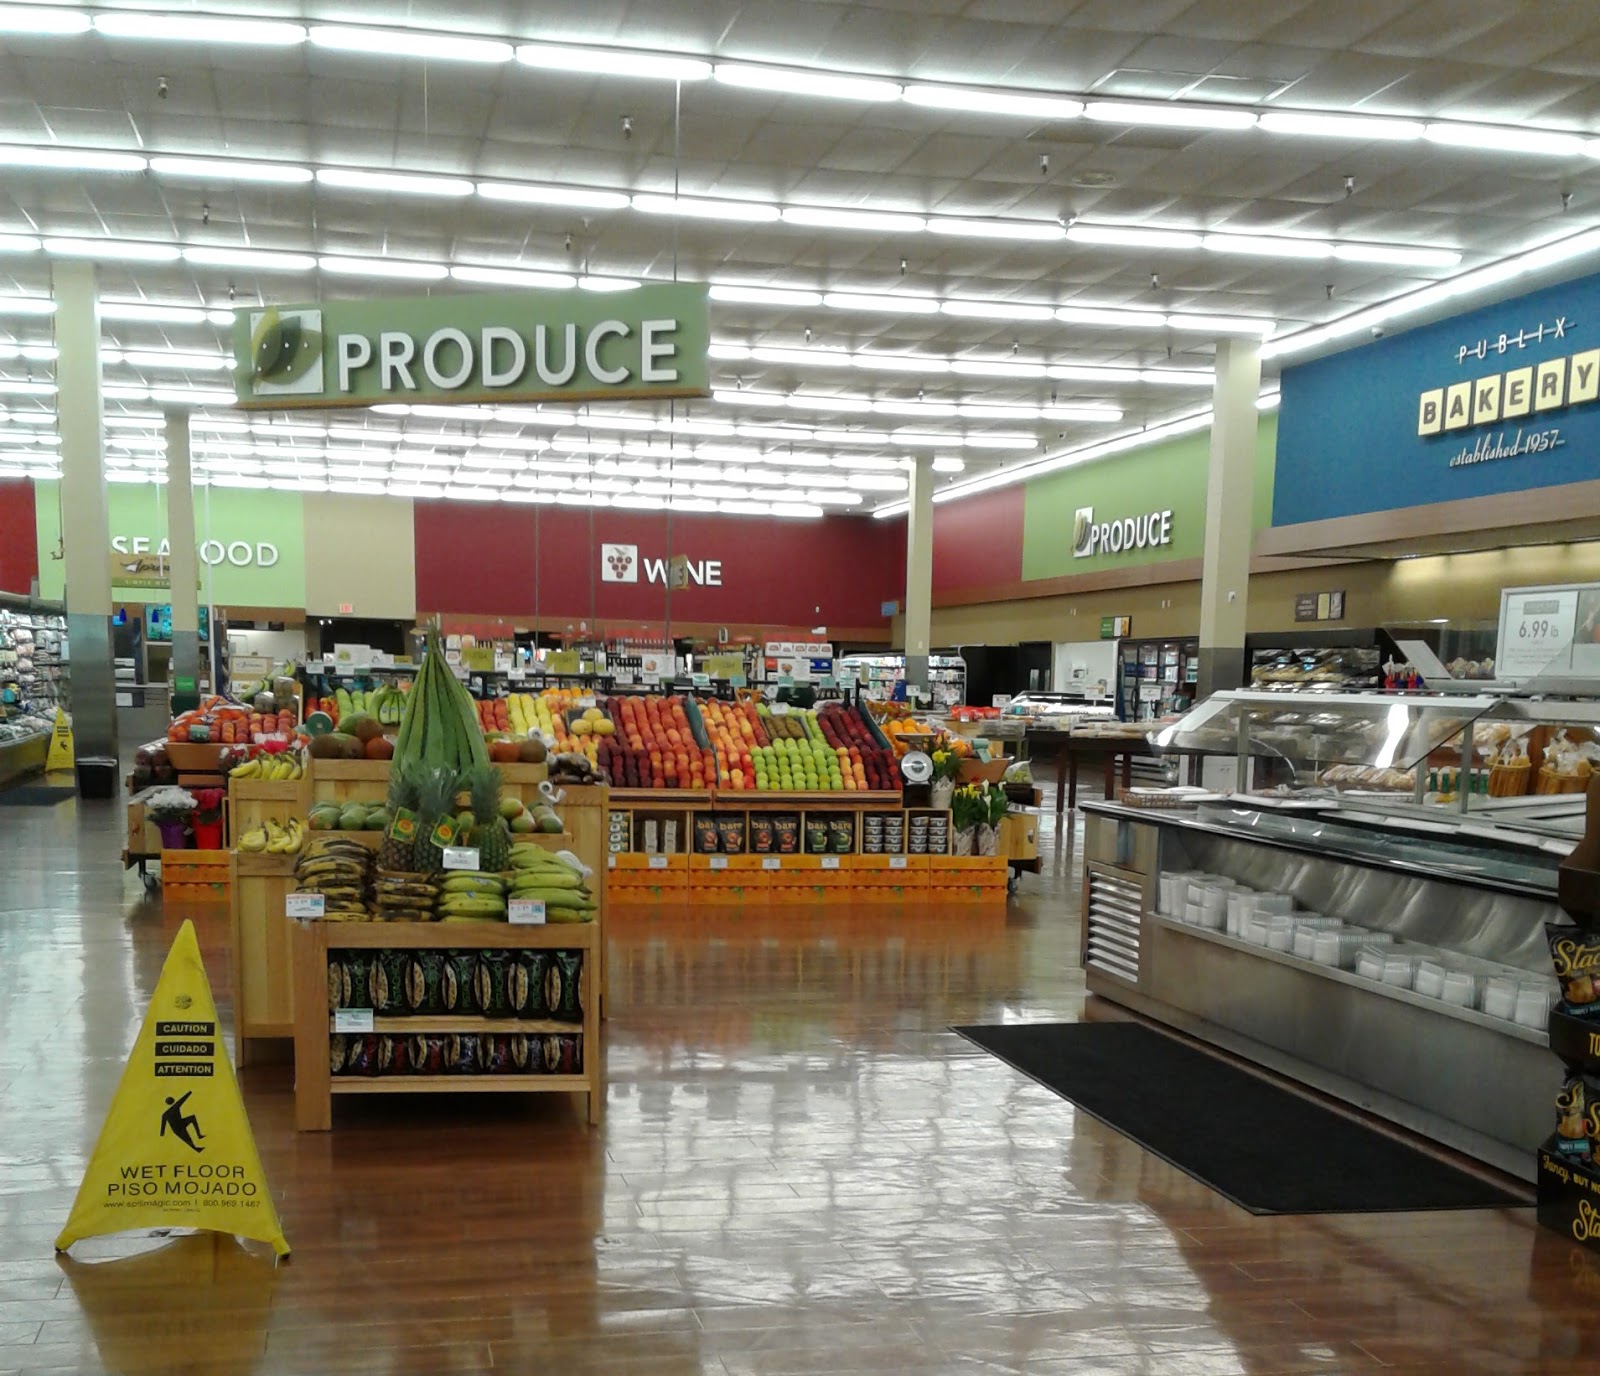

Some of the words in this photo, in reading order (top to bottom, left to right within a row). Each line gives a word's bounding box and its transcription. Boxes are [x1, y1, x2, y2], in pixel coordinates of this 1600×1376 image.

[1457, 316, 1568, 364] PUBLIX
[337, 318, 678, 391] PRODUCE
[1421, 361, 1594, 426] BAKERY
[1449, 429, 1522, 467] established
[1524, 429, 1560, 454] 1957
[1091, 510, 1171, 555] PRODUCE
[112, 536, 279, 567] SEAOOD
[643, 558, 722, 586] WNE
[1519, 620, 1549, 638] 6.99
[162, 1024, 208, 1033] CAUTION
[161, 1044, 208, 1054] CUIDADO
[157, 1064, 212, 1074] ATTENTION
[120, 1165, 167, 1180] WET
[174, 1164, 245, 1179] FLOOR
[1573, 1172, 1589, 1188] BUT
[108, 1182, 158, 1197] PISO
[165, 1181, 257, 1197] MOJADO
